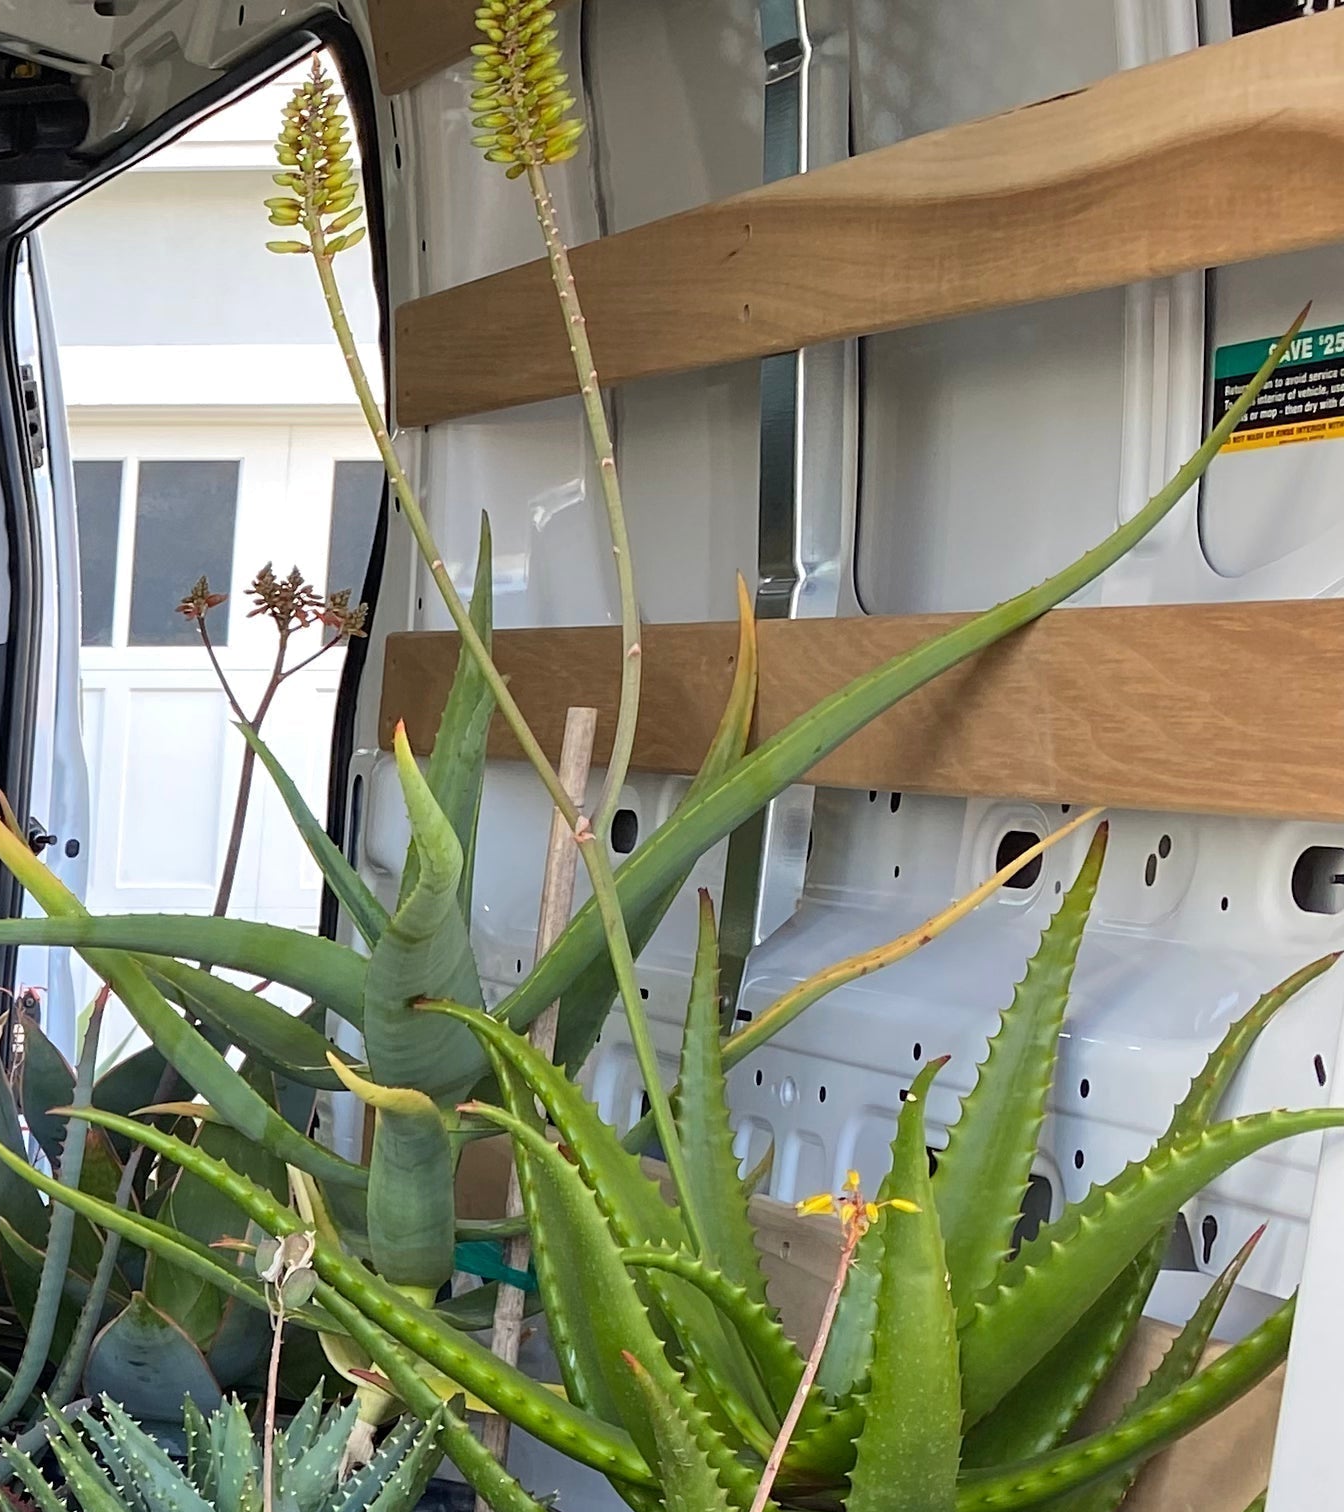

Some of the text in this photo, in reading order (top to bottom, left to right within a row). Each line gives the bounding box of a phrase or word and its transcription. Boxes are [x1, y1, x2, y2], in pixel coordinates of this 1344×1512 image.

[1275, 378, 1283, 388] to
[1285, 372, 1307, 386] avoid
[1308, 369, 1338, 382] service
[1257, 392, 1286, 404] interior
[1287, 388, 1297, 400] of
[1298, 384, 1329, 399] vehicle,
[1250, 411, 1259, 420] or
[1260, 408, 1277, 420] mop
[1285, 404, 1303, 415] then
[1304, 401, 1319, 413] dry
[1320, 397, 1338, 410] with
